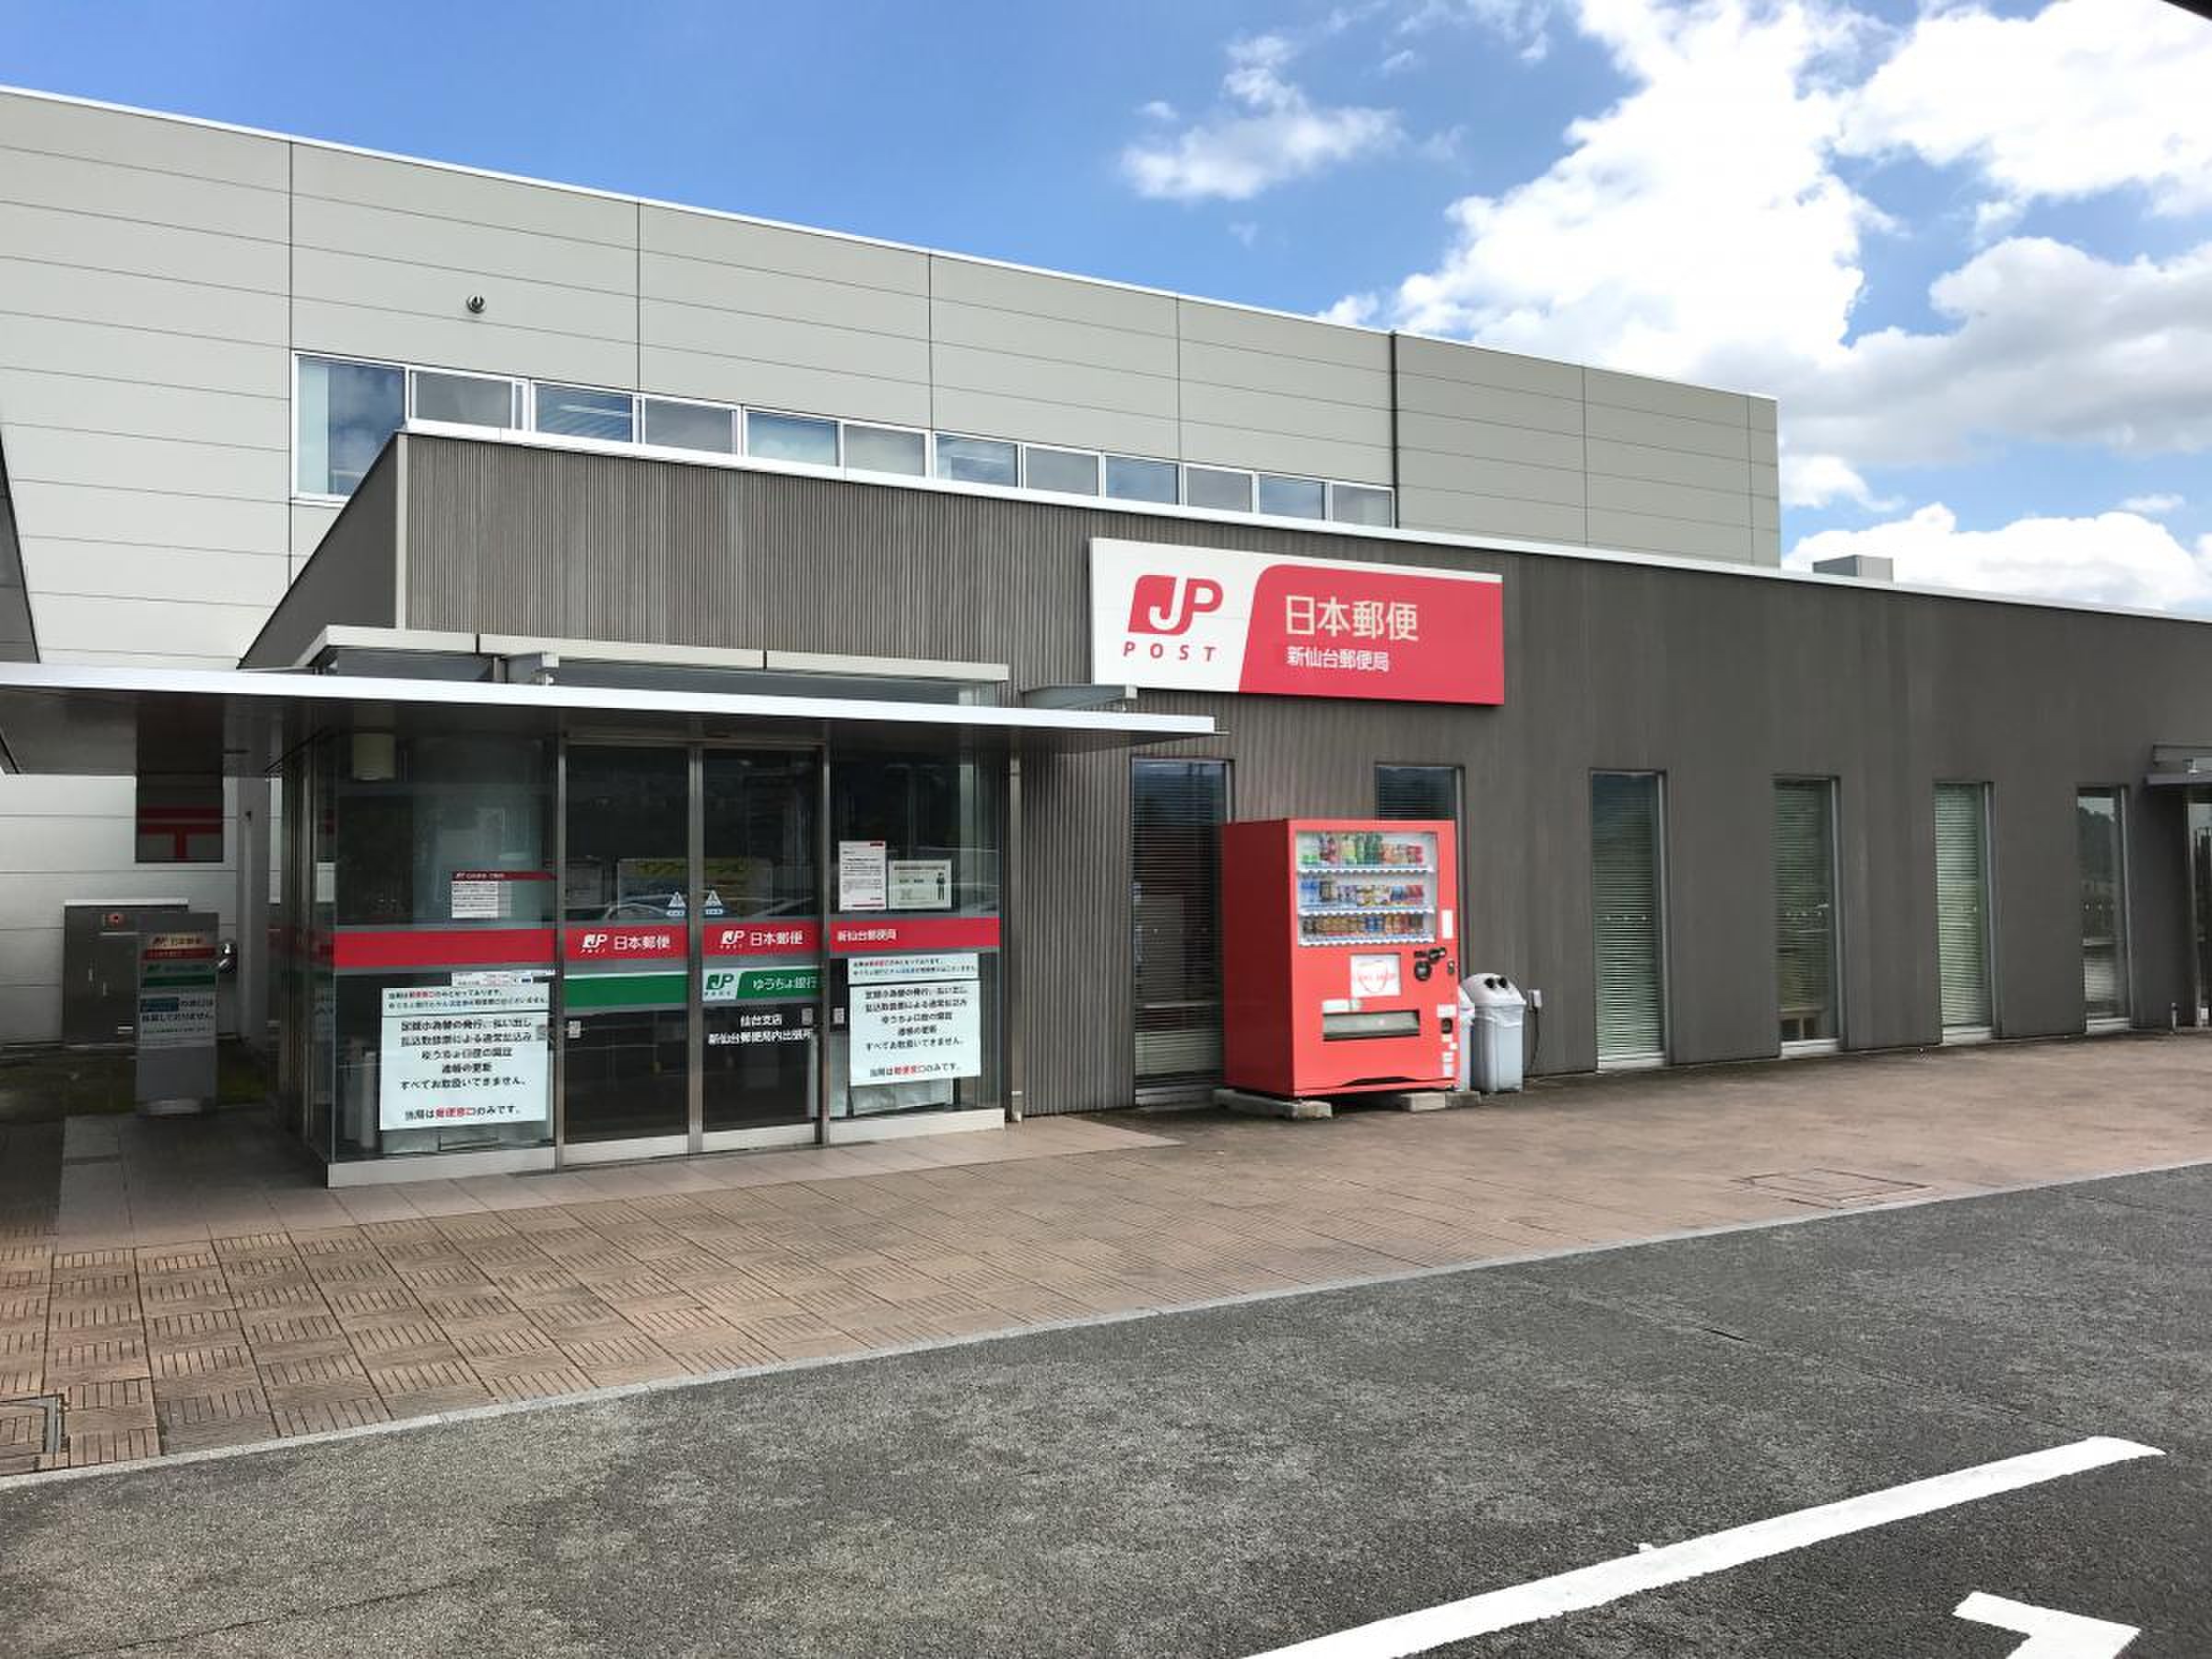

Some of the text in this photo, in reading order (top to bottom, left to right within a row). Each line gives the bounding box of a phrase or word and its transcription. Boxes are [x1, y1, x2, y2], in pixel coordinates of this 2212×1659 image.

[1128, 574, 1224, 636] JP
[1285, 594, 1420, 642] 日本郵便
[1123, 641, 1217, 663] POST
[1286, 645, 1390, 672] 新仙台郵便局
[614, 935, 671, 951] 日本郵便
[750, 929, 805, 947] 日本郵便
[752, 974, 818, 991] ゆうちょ銀行
[740, 1013, 782, 1028] 仙台支店
[708, 1028, 814, 1046] 新仙台郵便局内出張所
